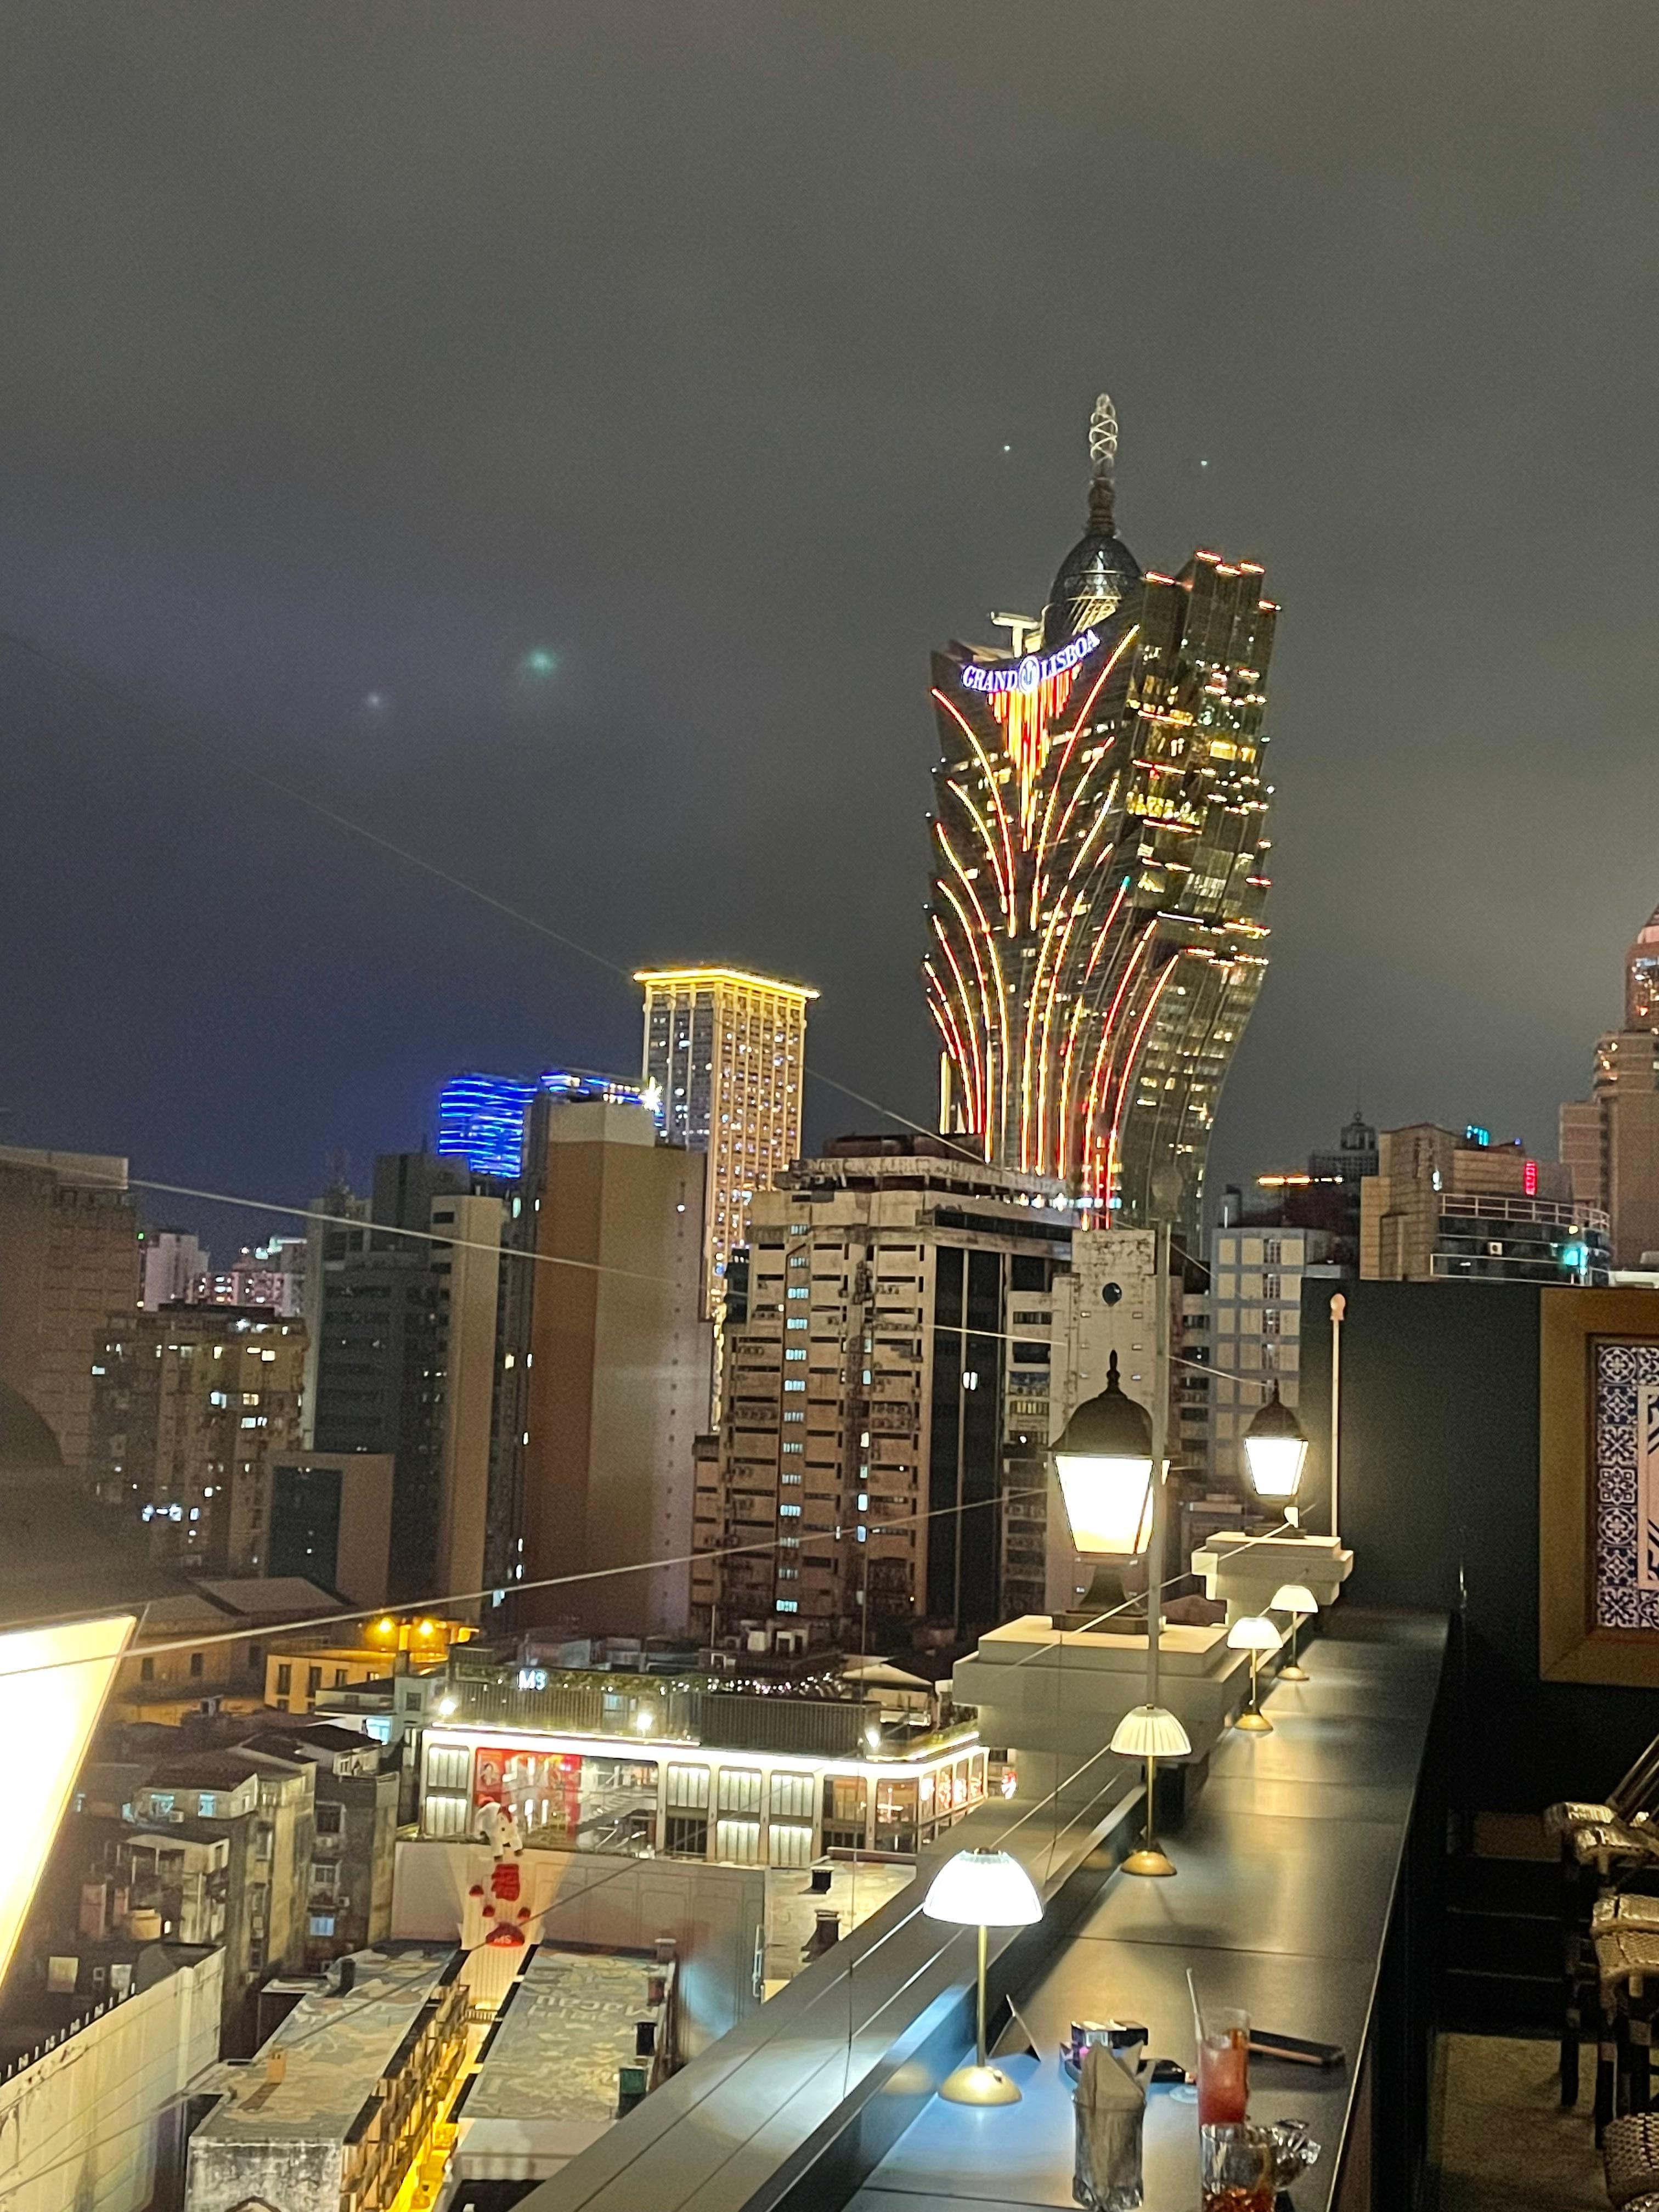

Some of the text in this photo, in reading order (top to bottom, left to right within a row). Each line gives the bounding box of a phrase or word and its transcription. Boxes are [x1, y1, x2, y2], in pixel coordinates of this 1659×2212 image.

[963, 629, 1101, 692] GRAND LISBOA
[535, 1995, 659, 2019] Macau
